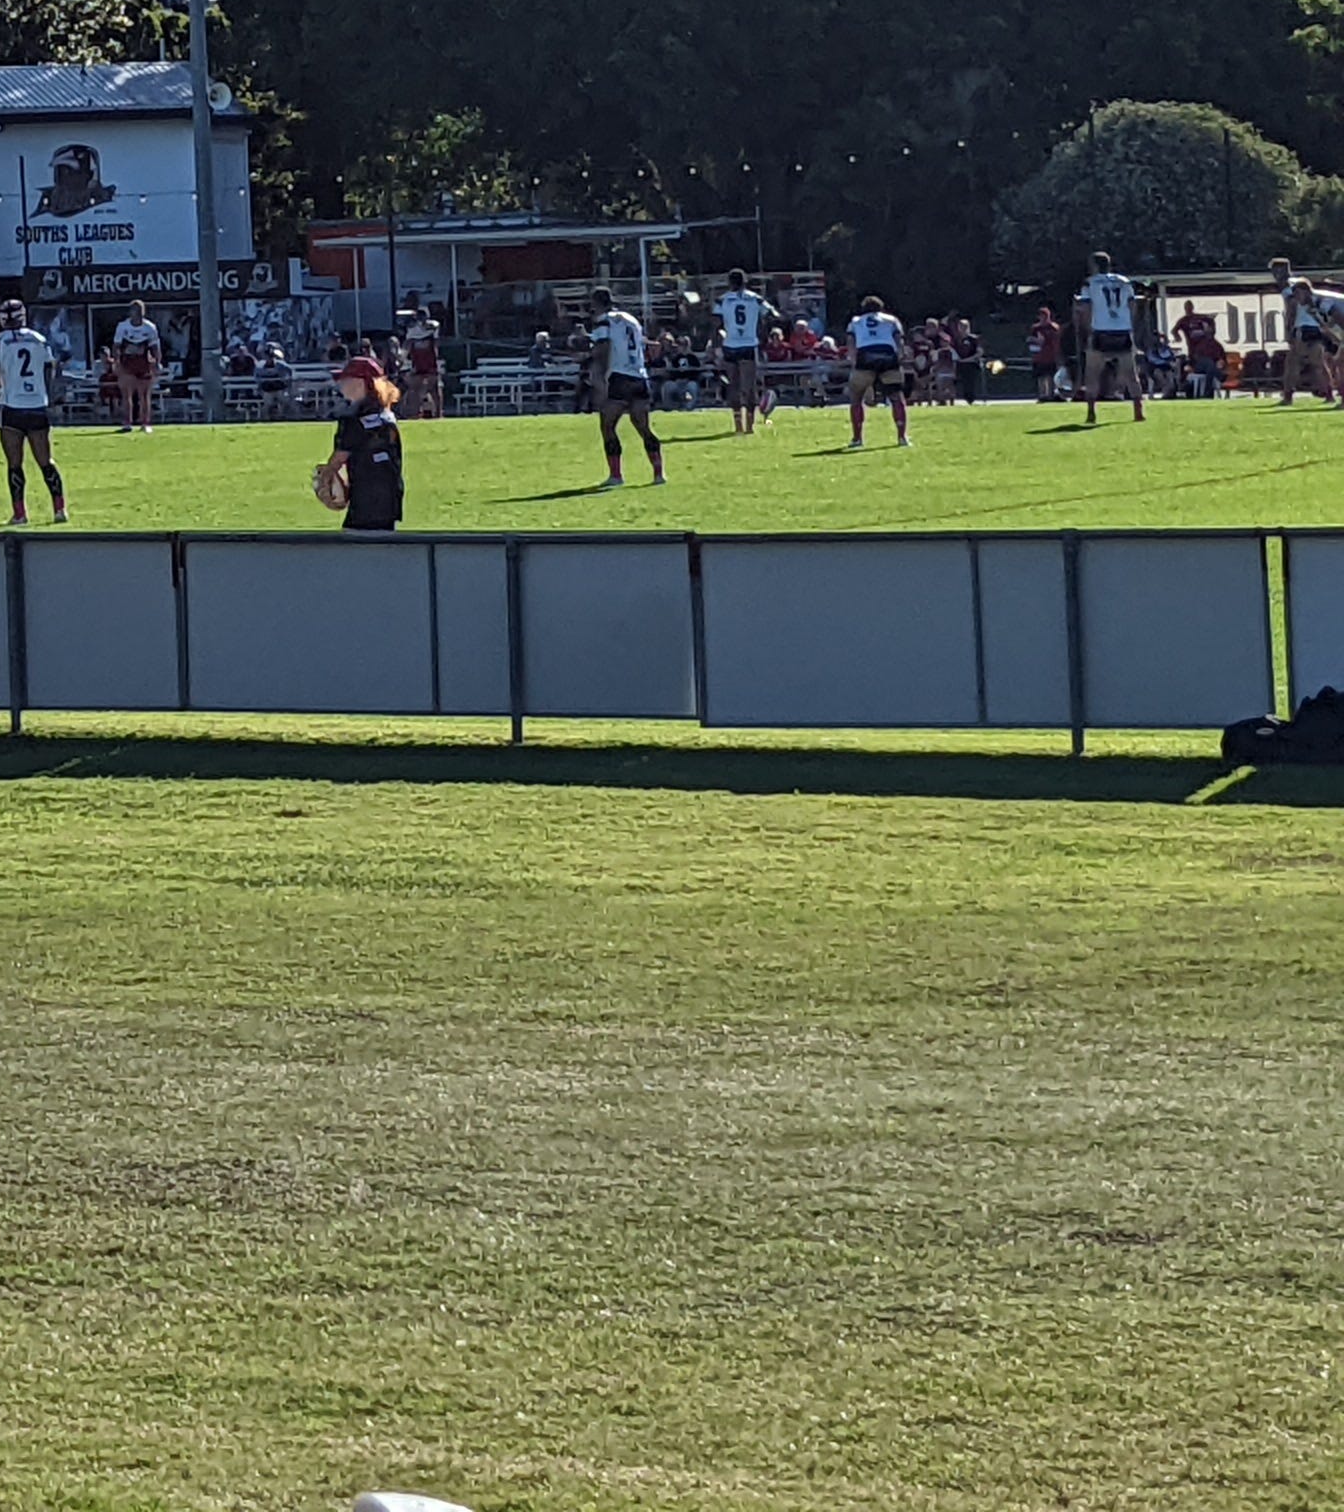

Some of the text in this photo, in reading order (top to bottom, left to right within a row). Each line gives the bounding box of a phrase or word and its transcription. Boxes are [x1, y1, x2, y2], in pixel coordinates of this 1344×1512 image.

[15, 222, 134, 244] SOUTHS LEAGUES
[58, 246, 93, 265] CLUB
[73, 269, 239, 293] MERCHANDISG
[735, 304, 746, 325] 6
[17, 348, 34, 377] 2
